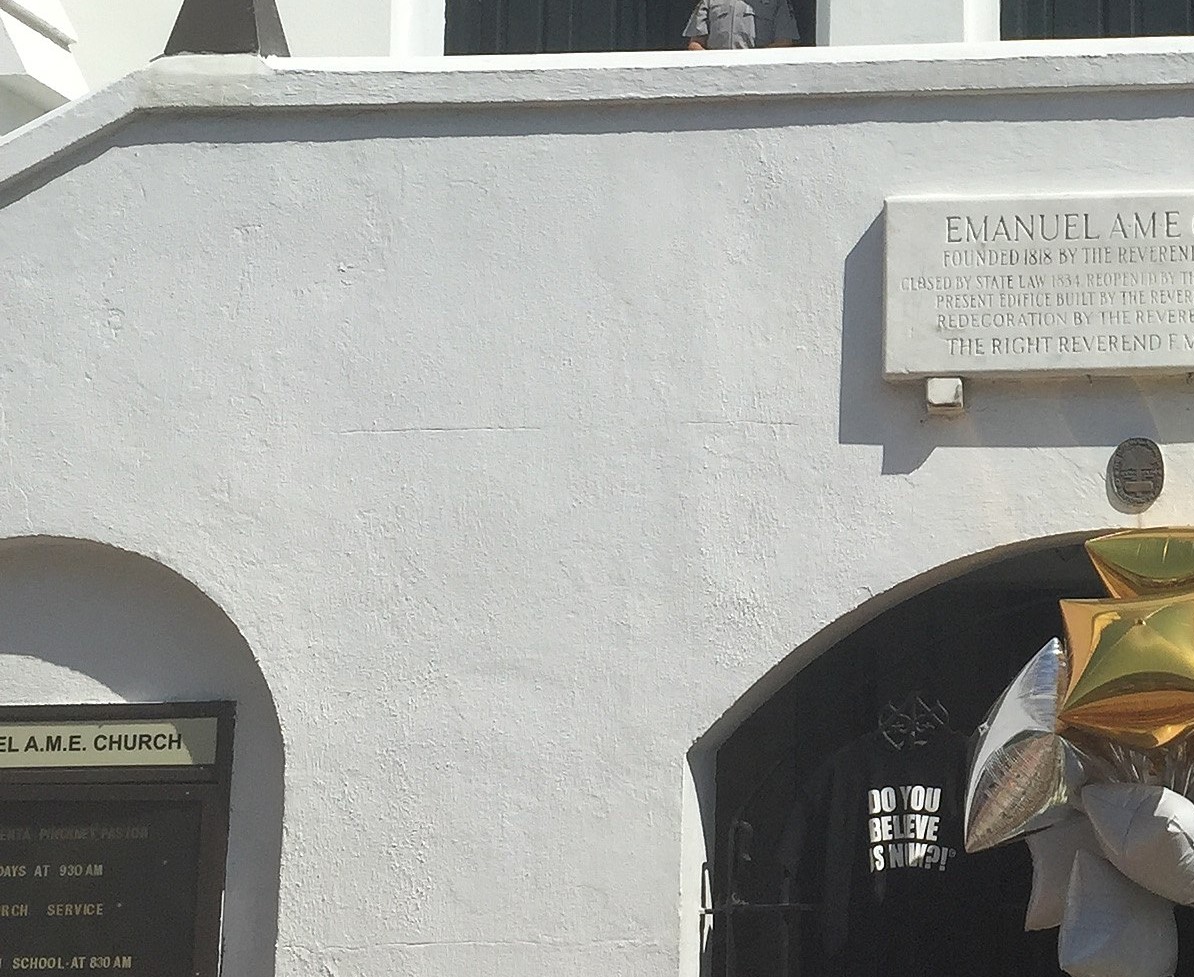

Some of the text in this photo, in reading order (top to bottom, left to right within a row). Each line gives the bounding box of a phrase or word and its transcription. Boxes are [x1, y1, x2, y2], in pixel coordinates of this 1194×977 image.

[945, 213, 1099, 243] EMANUEL
[943, 250, 1019, 268] FOUNDED
[1023, 248, 1052, 266] 1818
[1059, 248, 1077, 265] BY
[1082, 247, 1112, 264] THE
[901, 276, 951, 291] CLOSED
[956, 275, 972, 290] BY
[976, 274, 1014, 290] STATE
[1019, 274, 1046, 289] LAW
[1160, 271, 1175, 286] BY
[936, 293, 994, 309] PRESENT
[1000, 292, 1051, 308] EDIFICE
[1056, 292, 1095, 307] BUILT
[1100, 291, 1115, 305] BY
[1121, 290, 1145, 305] THE
[937, 311, 1067, 329] REDECORATION
[1074, 310, 1092, 325] BY
[1100, 310, 1131, 325] THE
[947, 337, 985, 356] THE
[991, 336, 1053, 354] RIGHT
[1058, 334, 1162, 353] REVEREND
[24, 734, 86, 752] A.M.E.
[94, 733, 182, 750] CHURCH
[868, 785, 941, 815] DO YOU
[34, 865, 50, 877] AT
[59, 864, 83, 877] 930
[85, 864, 103, 877] AM
[47, 903, 103, 916] SERVICE
[12, 956, 65, 970] SCHOOL
[70, 956, 86, 969] AT
[113, 955, 132, 969] AM
